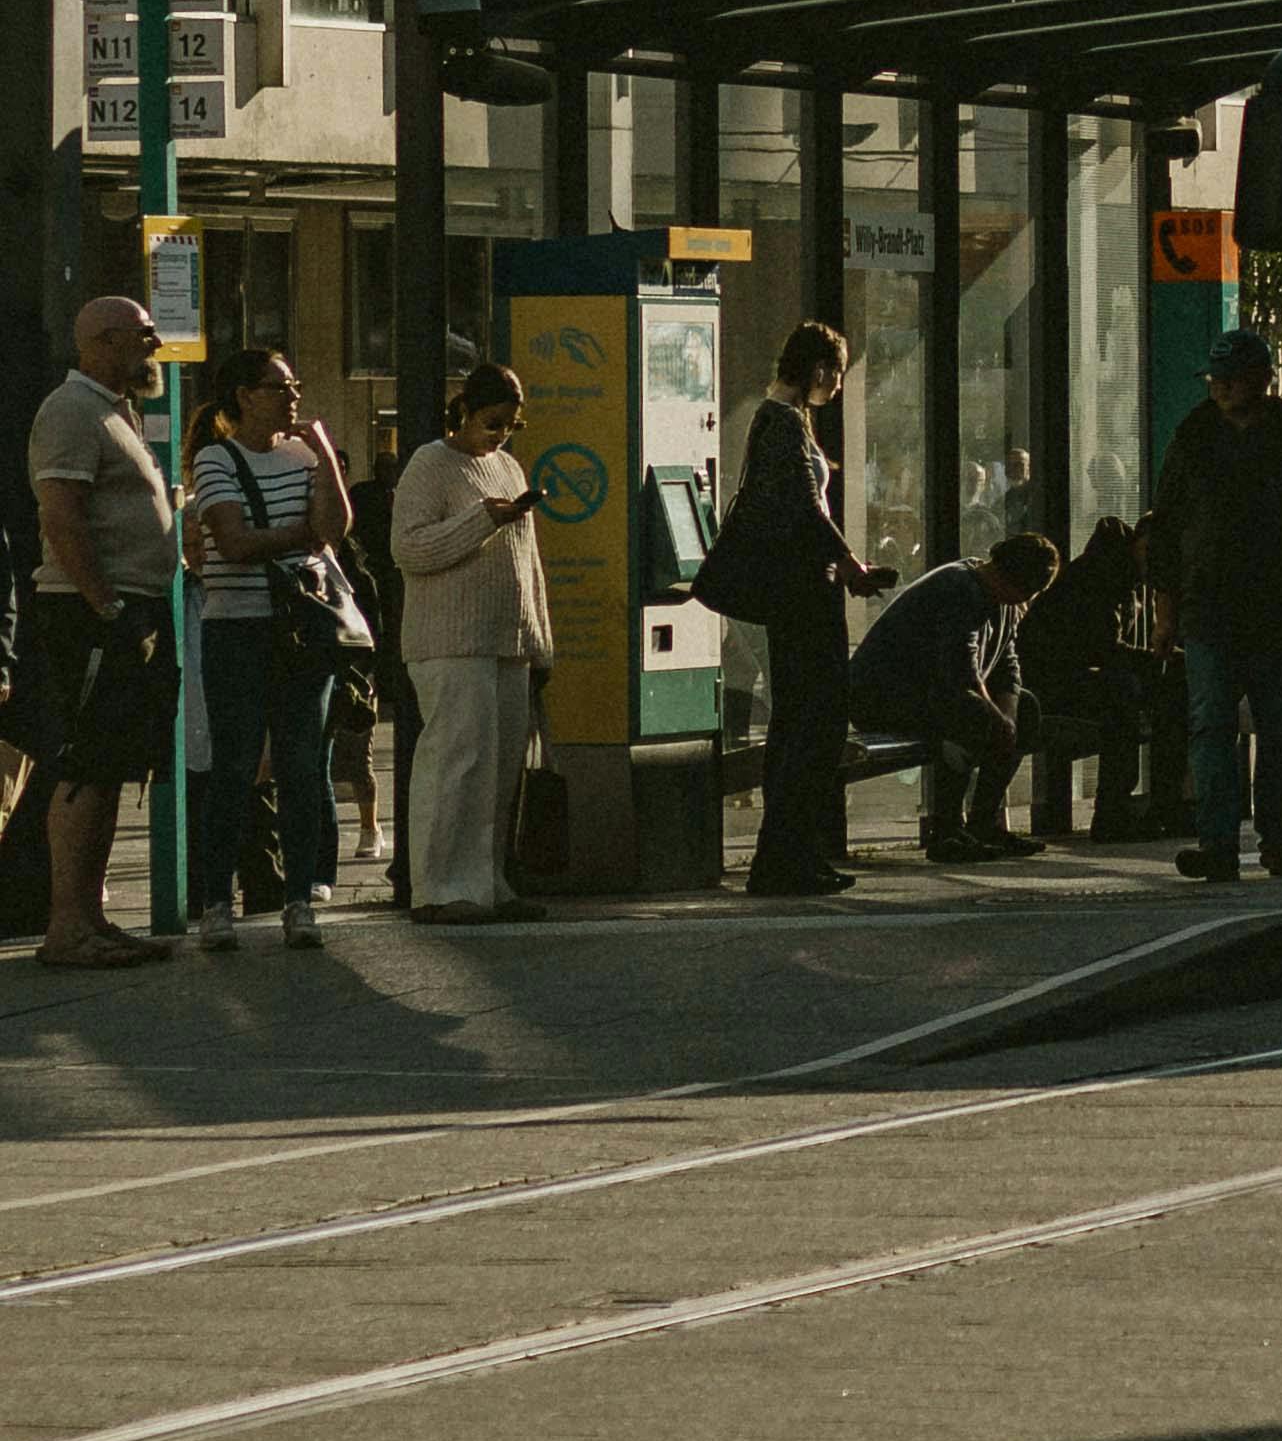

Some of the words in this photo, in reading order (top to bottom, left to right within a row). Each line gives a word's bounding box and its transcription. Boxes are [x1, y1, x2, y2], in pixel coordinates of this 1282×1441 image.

[92, 37, 132, 59] N11
[179, 34, 206, 57] 12
[91, 100, 137, 122] N12
[179, 97, 207, 120] 14
